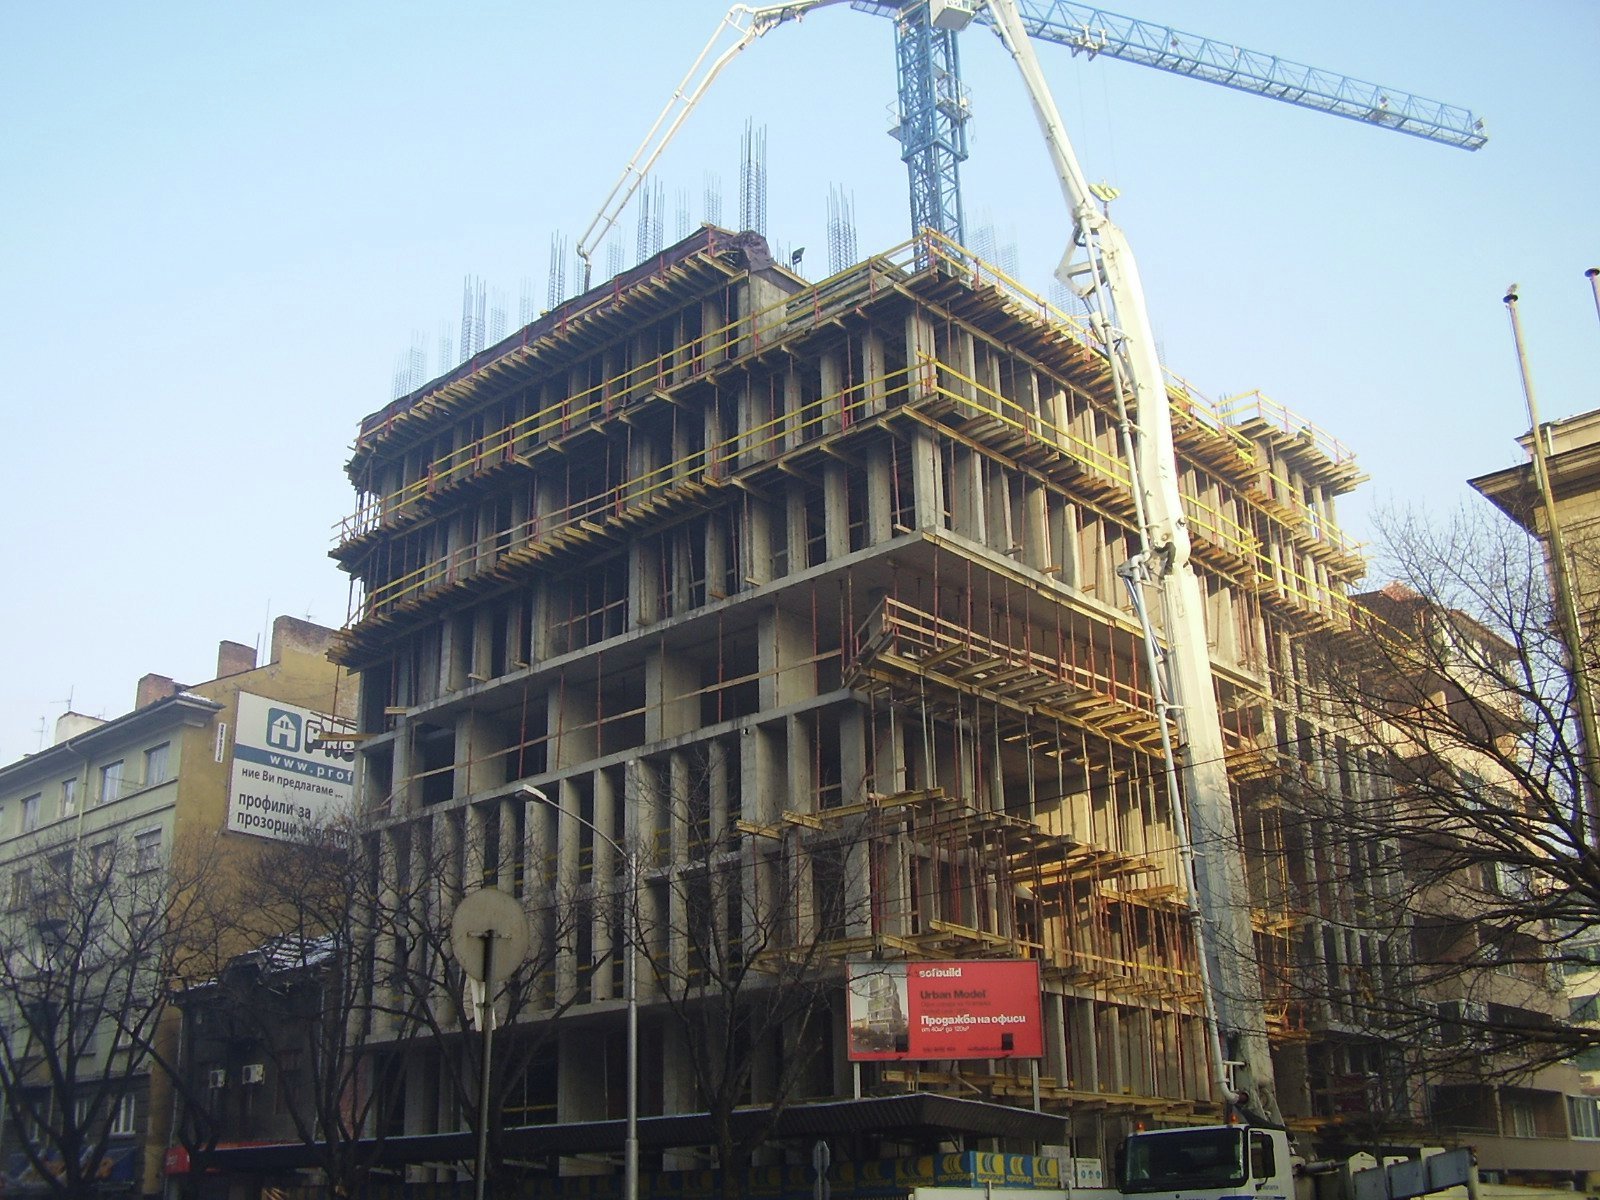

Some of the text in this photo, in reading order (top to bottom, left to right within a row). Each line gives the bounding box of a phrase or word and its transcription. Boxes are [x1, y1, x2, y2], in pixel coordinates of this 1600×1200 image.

[270, 754, 353, 781] www.prof
[242, 768, 260, 780] ние
[262, 771, 275, 783] Ви
[276, 776, 333, 796] предлагаме
[238, 793, 311, 820] профили за
[237, 812, 297, 835] прозорци
[919, 967, 962, 978] sofbuild
[920, 989, 986, 1000] Urban Model
[920, 1014, 1026, 1026] Продажба на офиси
